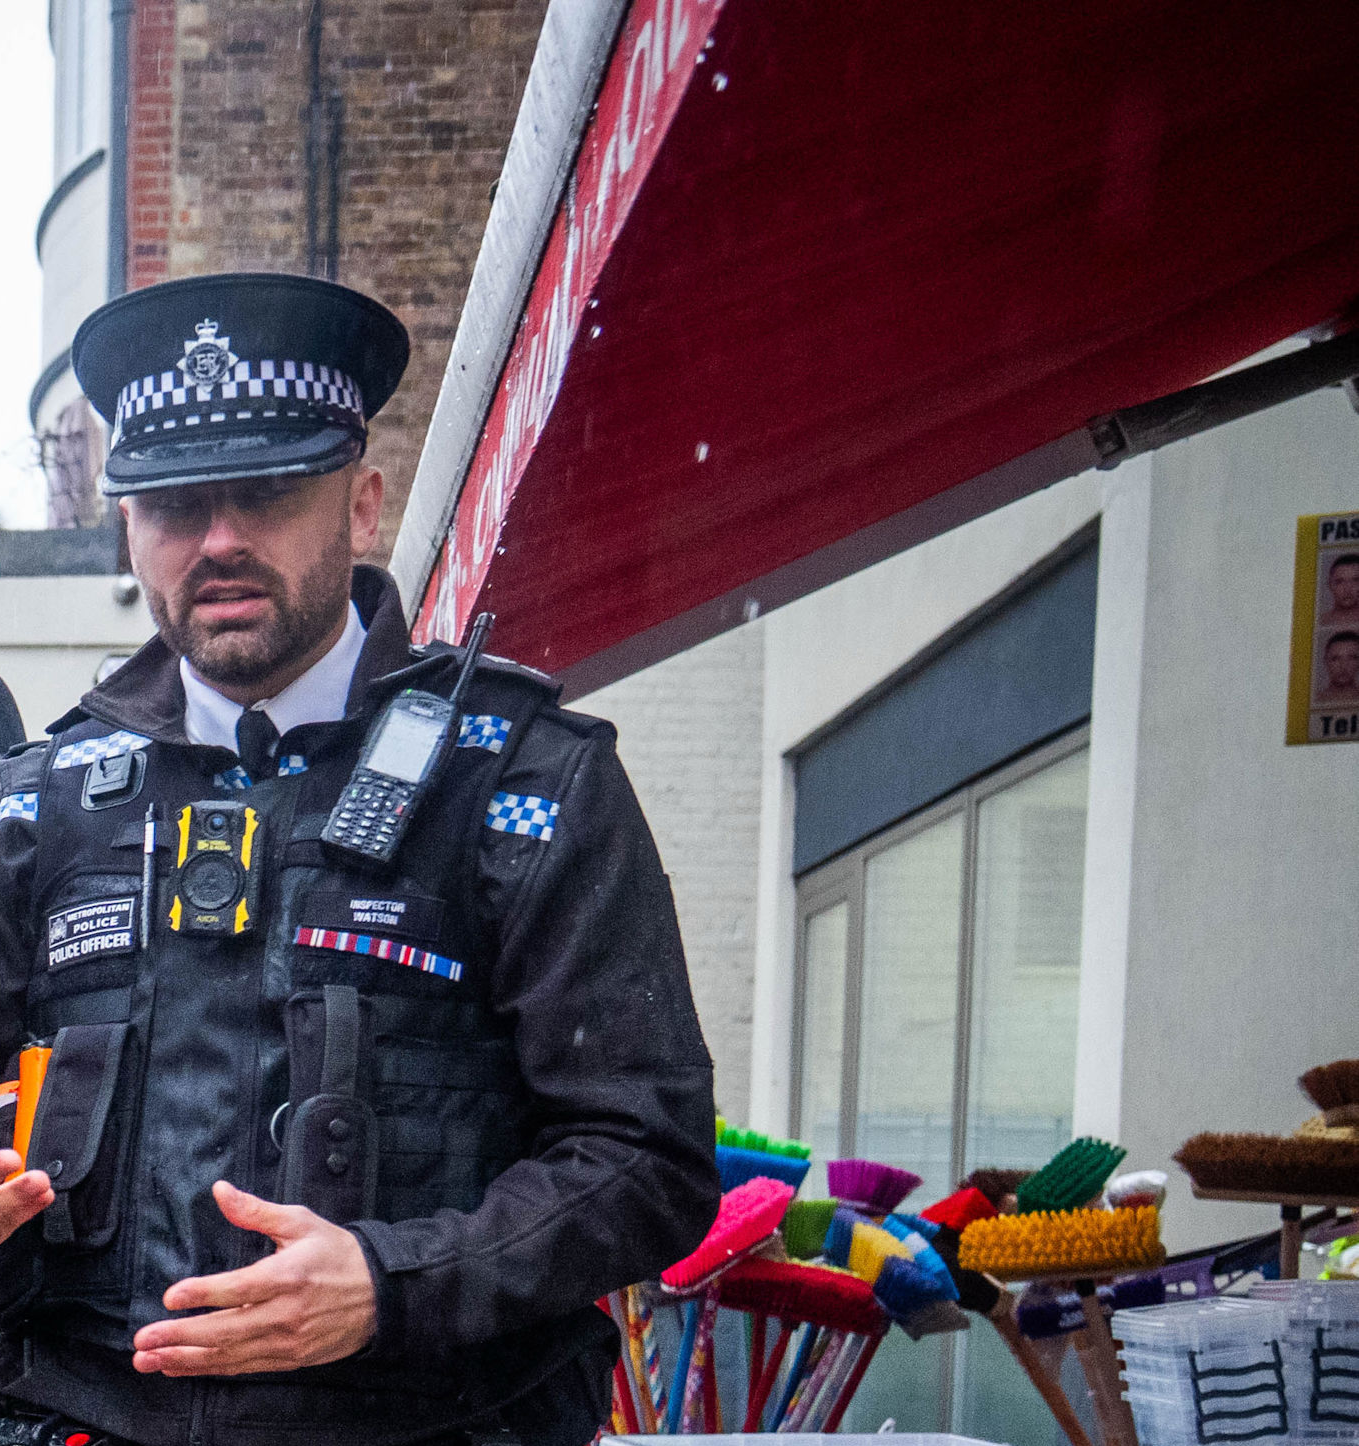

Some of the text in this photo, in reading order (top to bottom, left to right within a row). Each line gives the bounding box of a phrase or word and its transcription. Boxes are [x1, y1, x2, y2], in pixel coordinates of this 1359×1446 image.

[1321, 518, 1359, 542] PAS
[1320, 714, 1358, 737] Tel
[67, 903, 130, 922] METROPOLITAN
[349, 900, 406, 913] INSPECTOR
[73, 916, 119, 934] POLICE
[353, 912, 398, 925] WATSON
[49, 932, 131, 966] POLICE OFFICER
